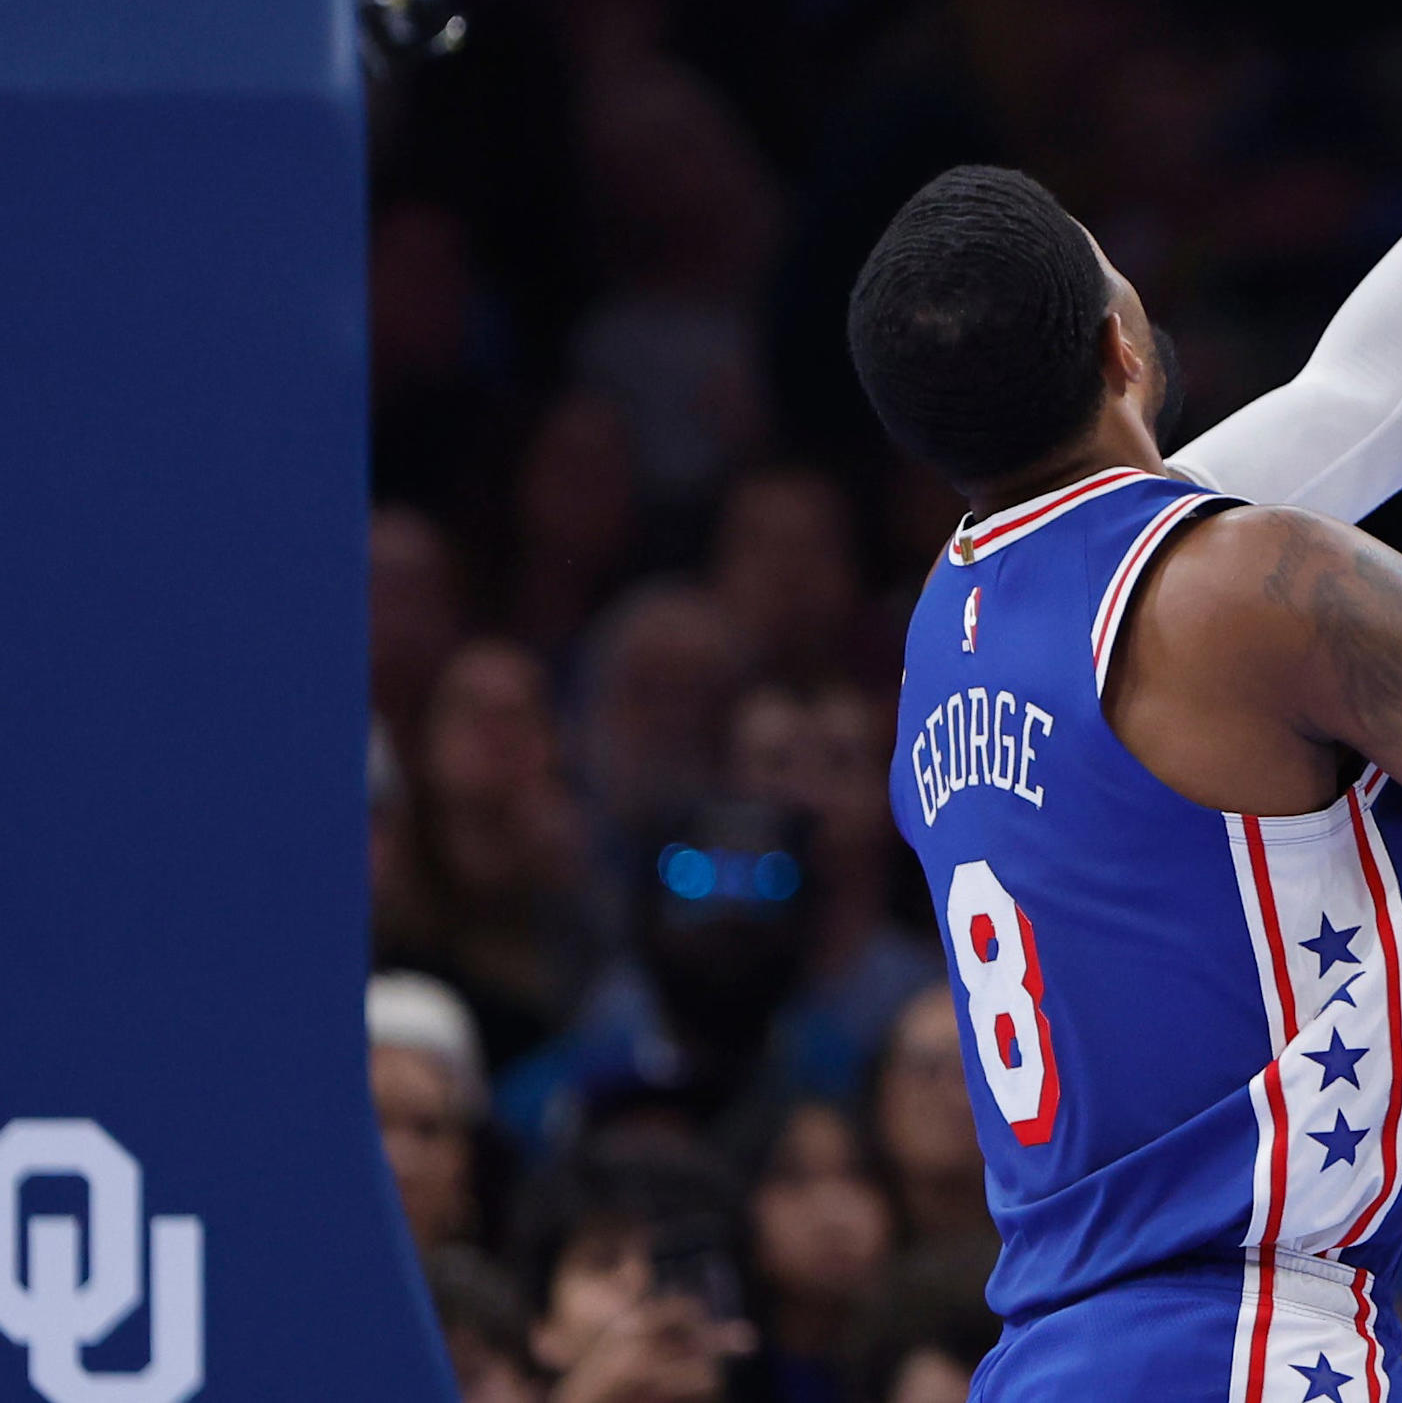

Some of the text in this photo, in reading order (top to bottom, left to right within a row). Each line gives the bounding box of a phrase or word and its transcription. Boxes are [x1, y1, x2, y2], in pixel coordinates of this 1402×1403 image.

[911, 686, 1054, 829] GEORGE
[946, 858, 1060, 1147] 8
[0, 1117, 206, 1403] OU
